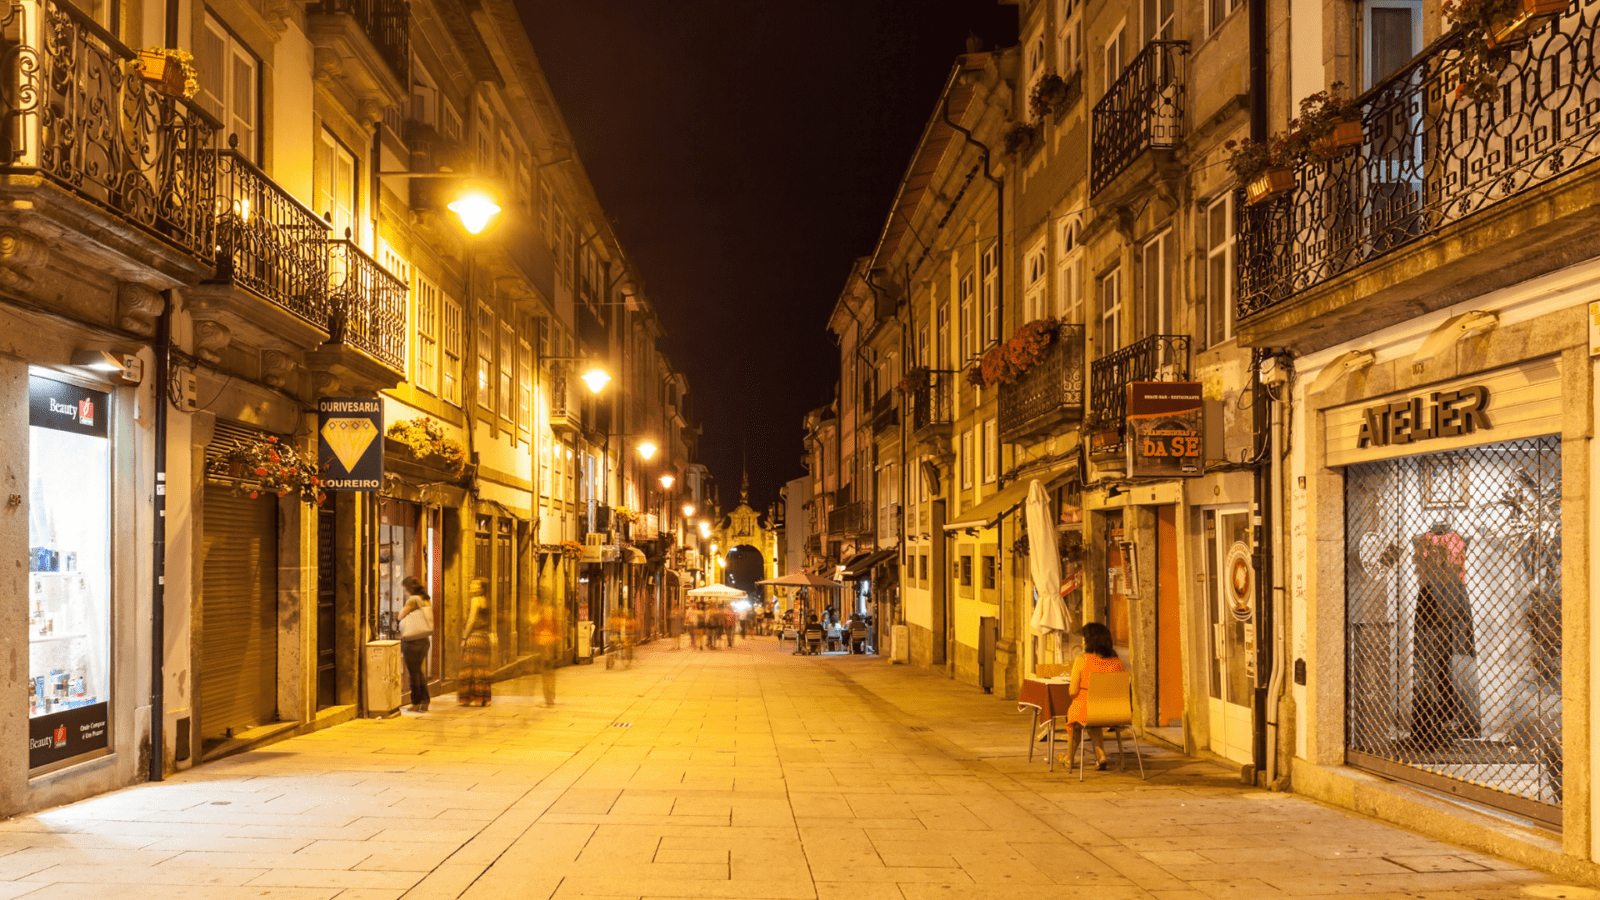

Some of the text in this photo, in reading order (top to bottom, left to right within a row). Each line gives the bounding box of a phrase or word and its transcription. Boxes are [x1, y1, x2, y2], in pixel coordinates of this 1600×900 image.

[49, 397, 78, 420] Beauty
[320, 401, 380, 412] OURIVESARIA
[1143, 431, 1199, 457] DA SÉ
[320, 479, 380, 488] LOUREIRO
[29, 736, 53, 750] Beauty
